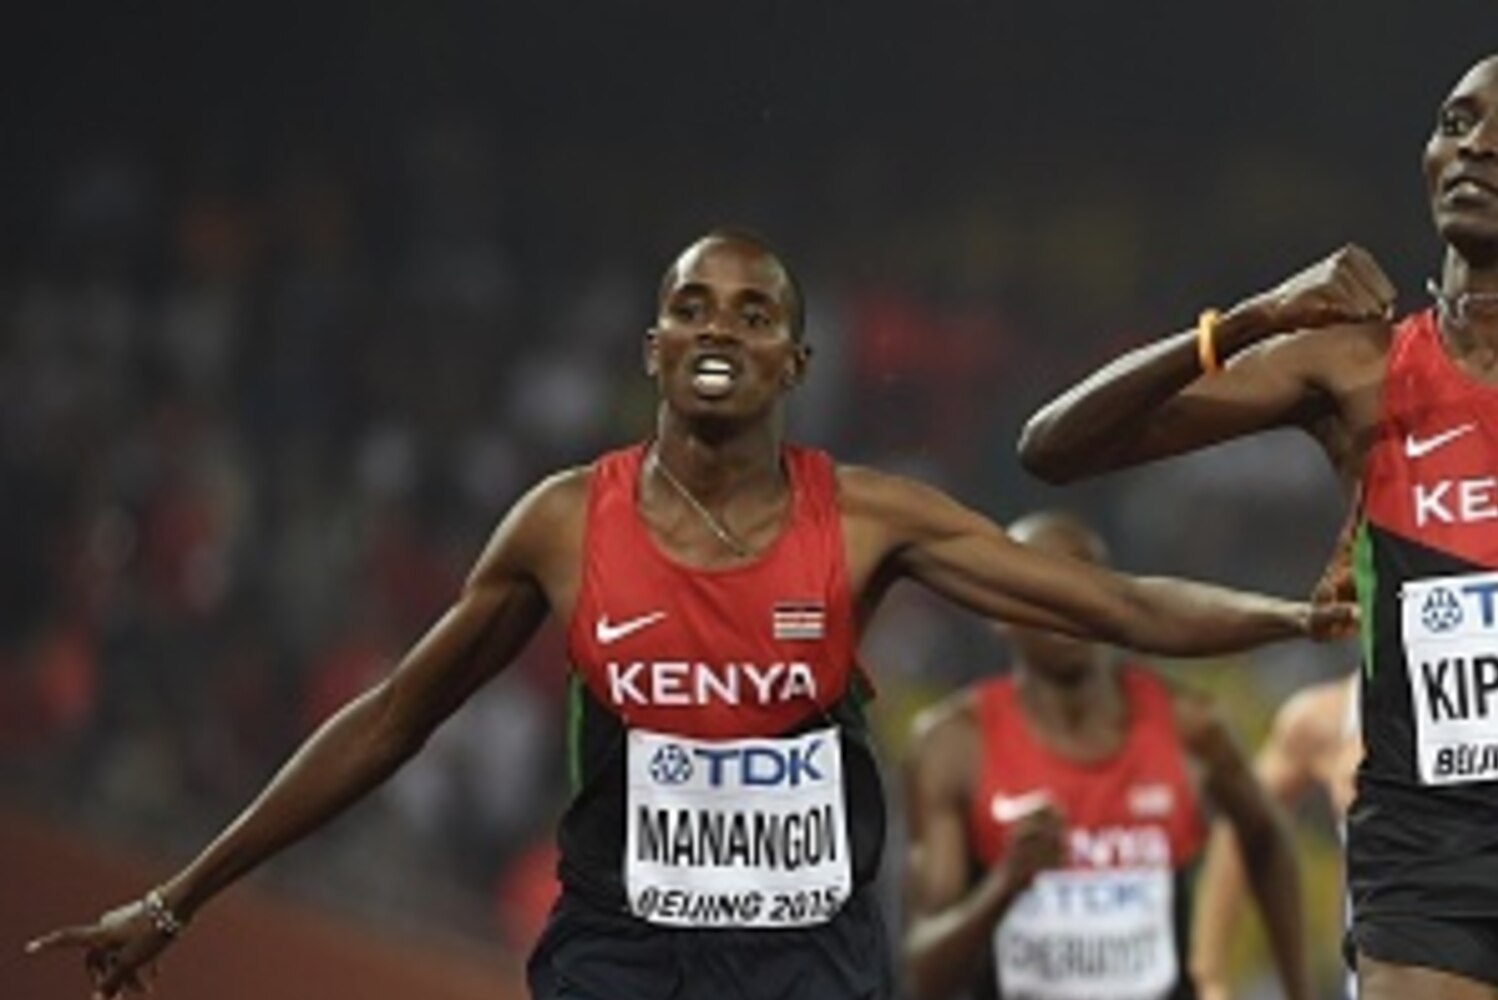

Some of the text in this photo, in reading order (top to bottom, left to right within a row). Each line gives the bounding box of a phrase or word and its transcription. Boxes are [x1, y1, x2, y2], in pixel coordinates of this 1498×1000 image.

[606, 661, 817, 705] KENYA
[694, 738, 826, 787] TDK
[637, 803, 837, 871] MANANGOI
[637, 885, 842, 922] BEIJING 2015
